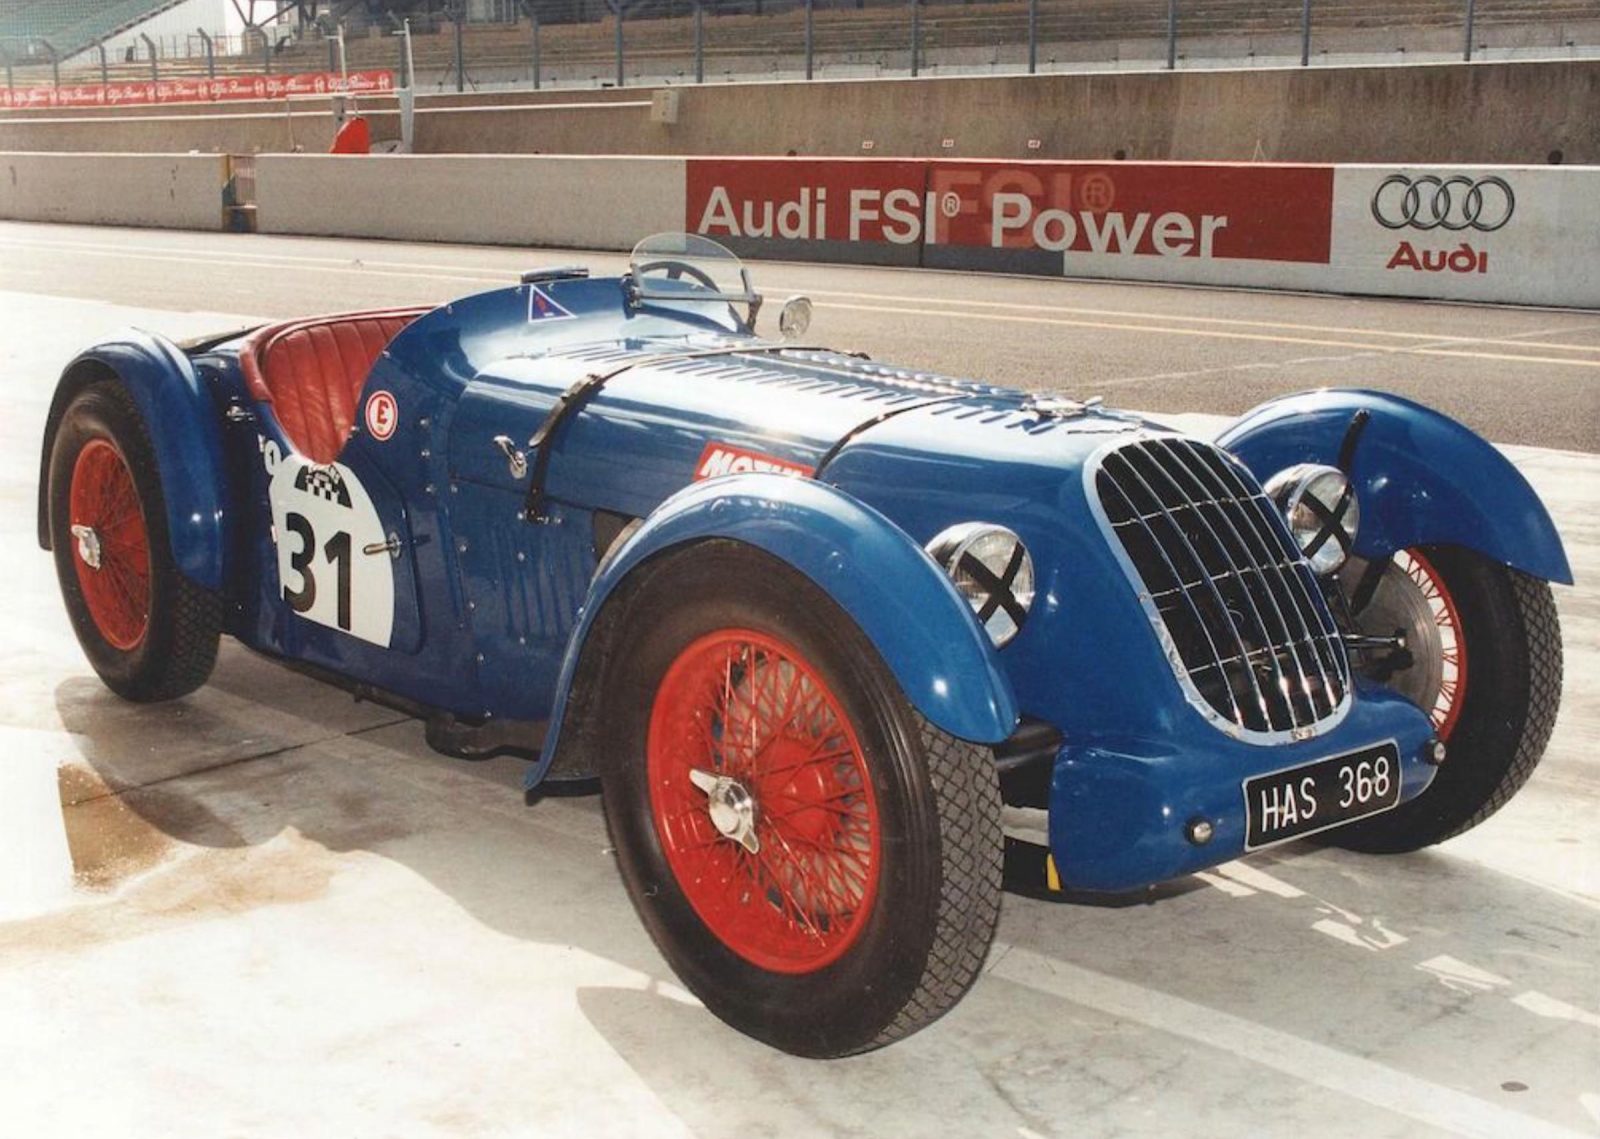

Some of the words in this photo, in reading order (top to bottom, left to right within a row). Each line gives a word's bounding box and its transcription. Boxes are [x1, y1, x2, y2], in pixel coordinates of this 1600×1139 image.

[698, 187, 826, 240] Audi
[991, 192, 1228, 258] Power
[1386, 241, 1488, 273] Audi
[377, 399, 389, 424] E
[283, 512, 351, 631] 31
[1261, 776, 1317, 832] HAS
[1338, 756, 1390, 809] 368
